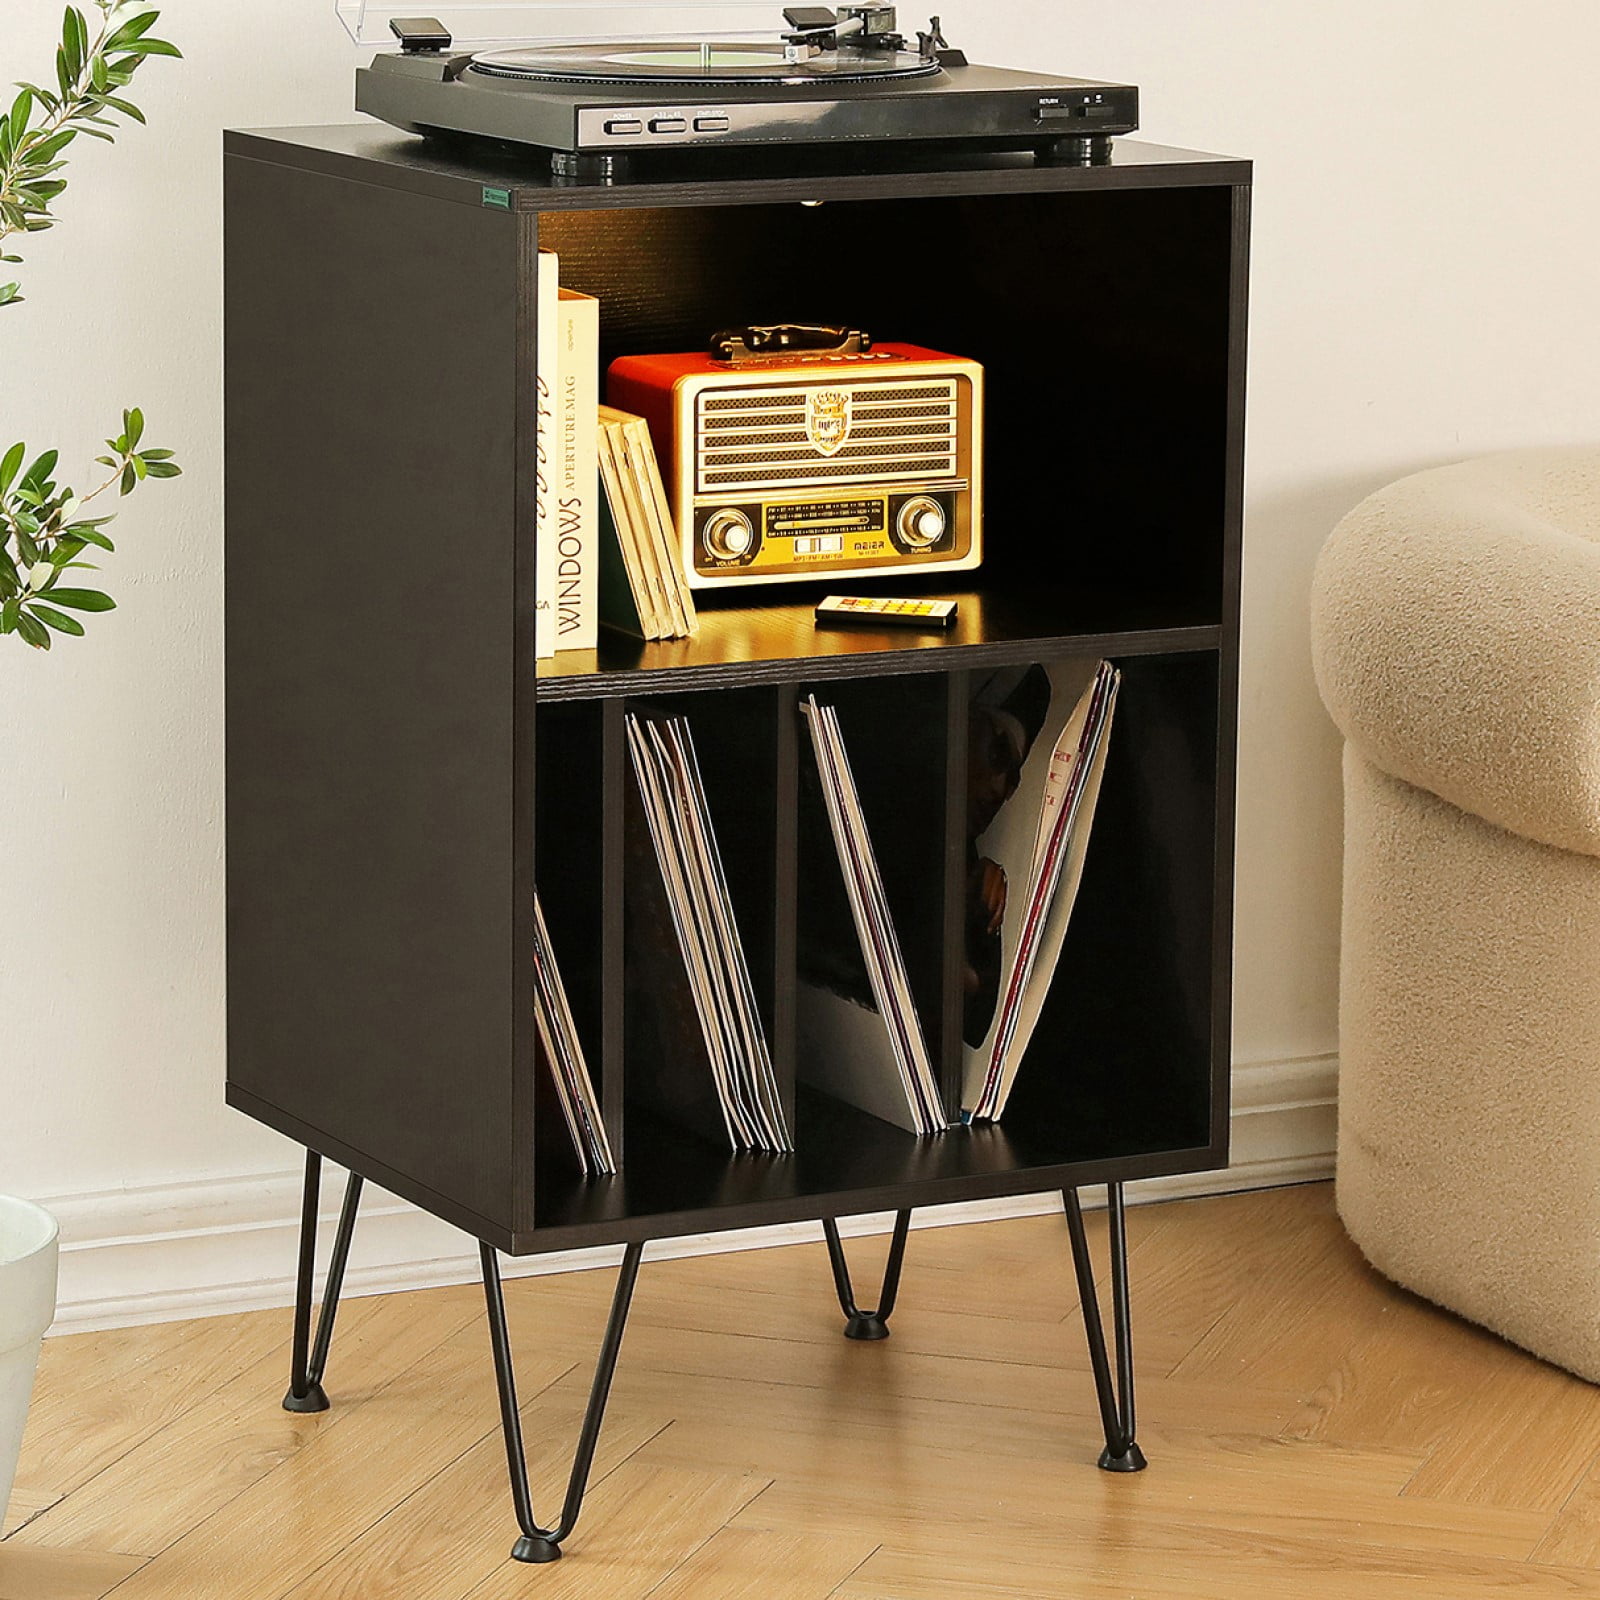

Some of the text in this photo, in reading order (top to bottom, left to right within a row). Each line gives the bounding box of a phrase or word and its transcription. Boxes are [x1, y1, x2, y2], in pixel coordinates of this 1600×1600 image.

[565, 375, 576, 491] APERTURE MAG
[558, 497, 582, 636] WINDOWS
[715, 559, 741, 567] VOLUME
